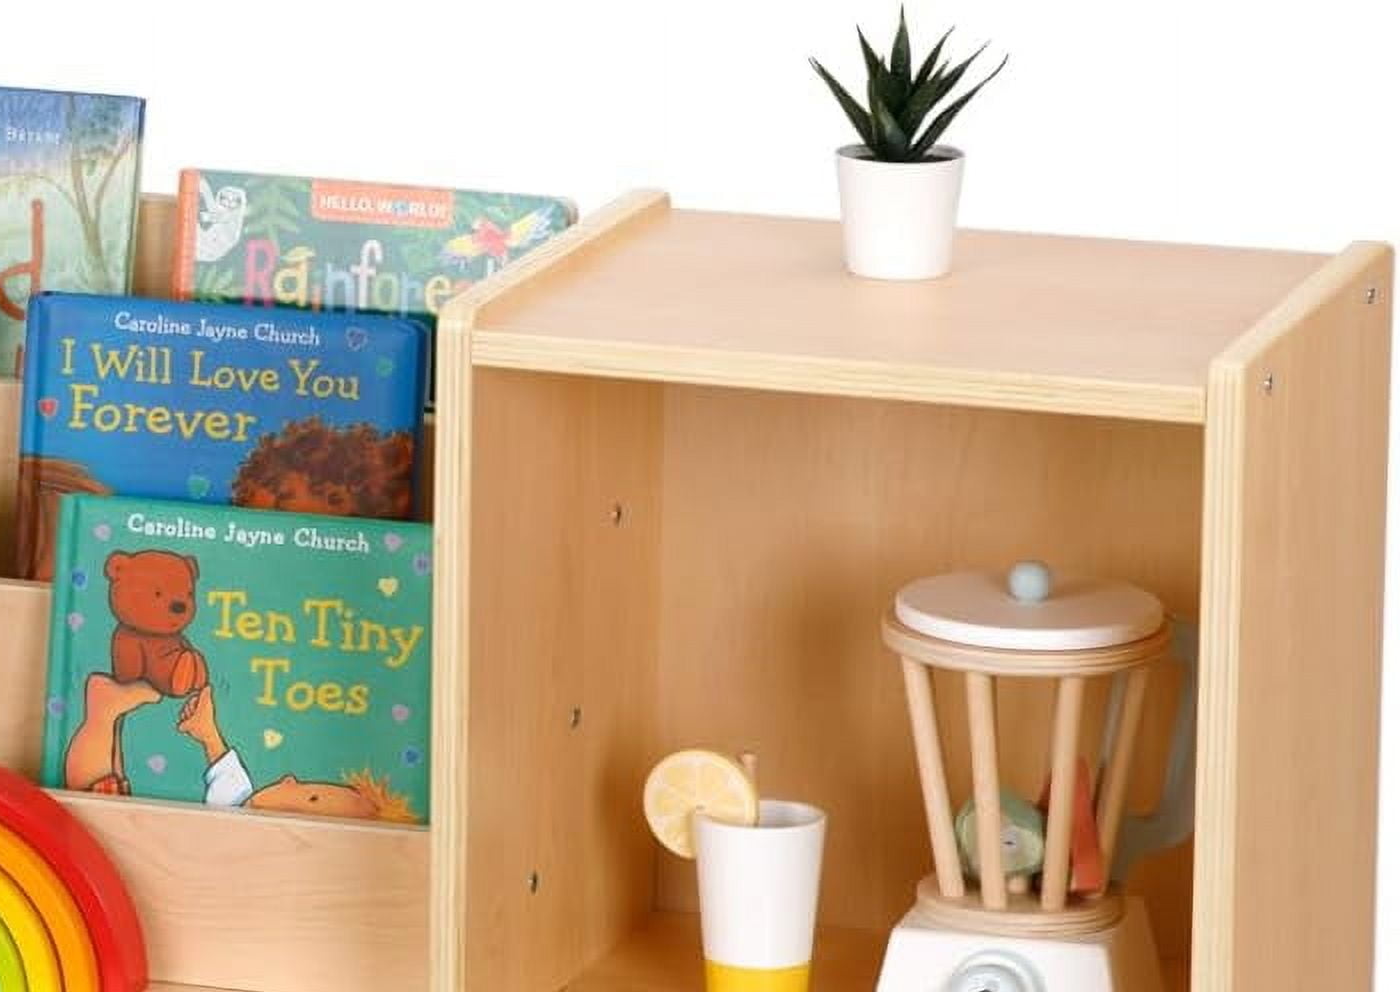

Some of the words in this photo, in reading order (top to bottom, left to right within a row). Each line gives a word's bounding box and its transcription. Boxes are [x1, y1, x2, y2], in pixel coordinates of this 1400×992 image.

[114, 311, 191, 338] Caroline
[196, 317, 248, 344] Jayne
[253, 322, 321, 348] Church
[61, 338, 75, 376] I
[90, 343, 171, 386] Will
[190, 350, 280, 394] Love
[288, 358, 361, 400] You
[68, 383, 260, 442] Forever
[127, 513, 217, 541] Caroline
[223, 520, 285, 548] Jayne
[294, 527, 370, 554] Church
[207, 588, 295, 644] Ten
[304, 598, 425, 669] Tiny
[250, 656, 370, 716] Toes
